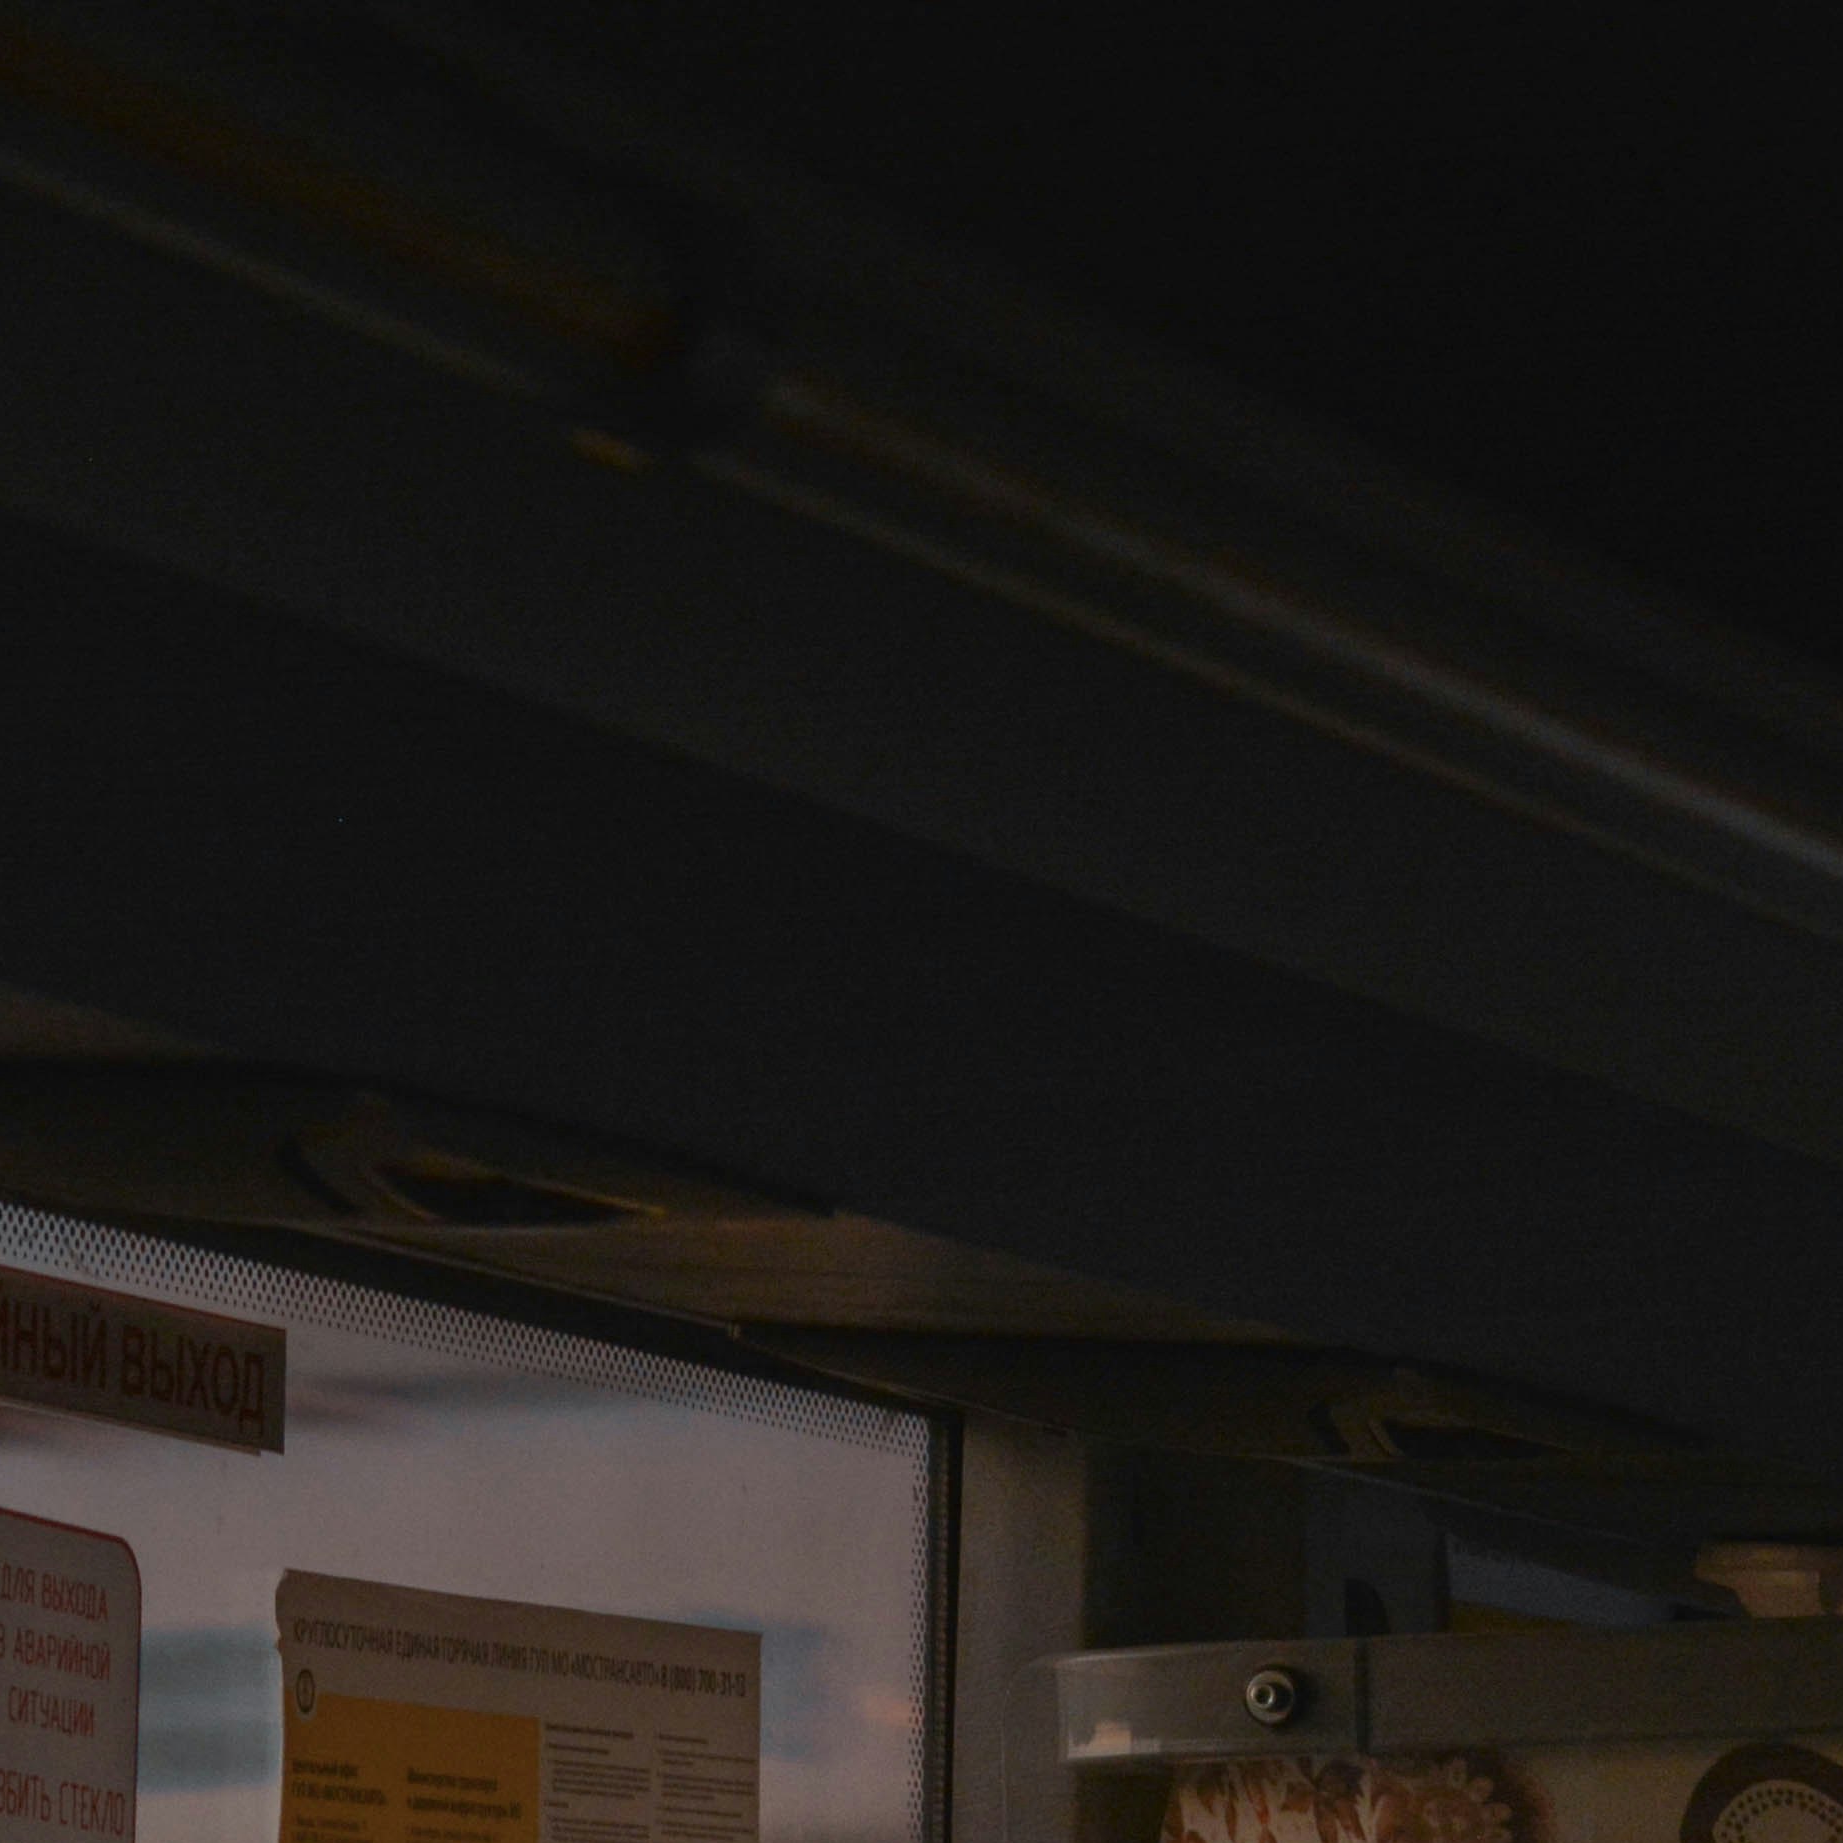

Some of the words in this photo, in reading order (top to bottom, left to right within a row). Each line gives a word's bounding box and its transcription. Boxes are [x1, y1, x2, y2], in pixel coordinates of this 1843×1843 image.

[121, 1326, 265, 1438] ВЫХОД
[0, 1563, 35, 1604] ДЛЯ
[41, 1573, 108, 1623] ВЫХОДА
[13, 1627, 111, 1683] АВАРИЙНОЙ
[9, 1686, 95, 1737] СИТУАЦИИ
[59, 1781, 126, 1837] СТЕКЛО
